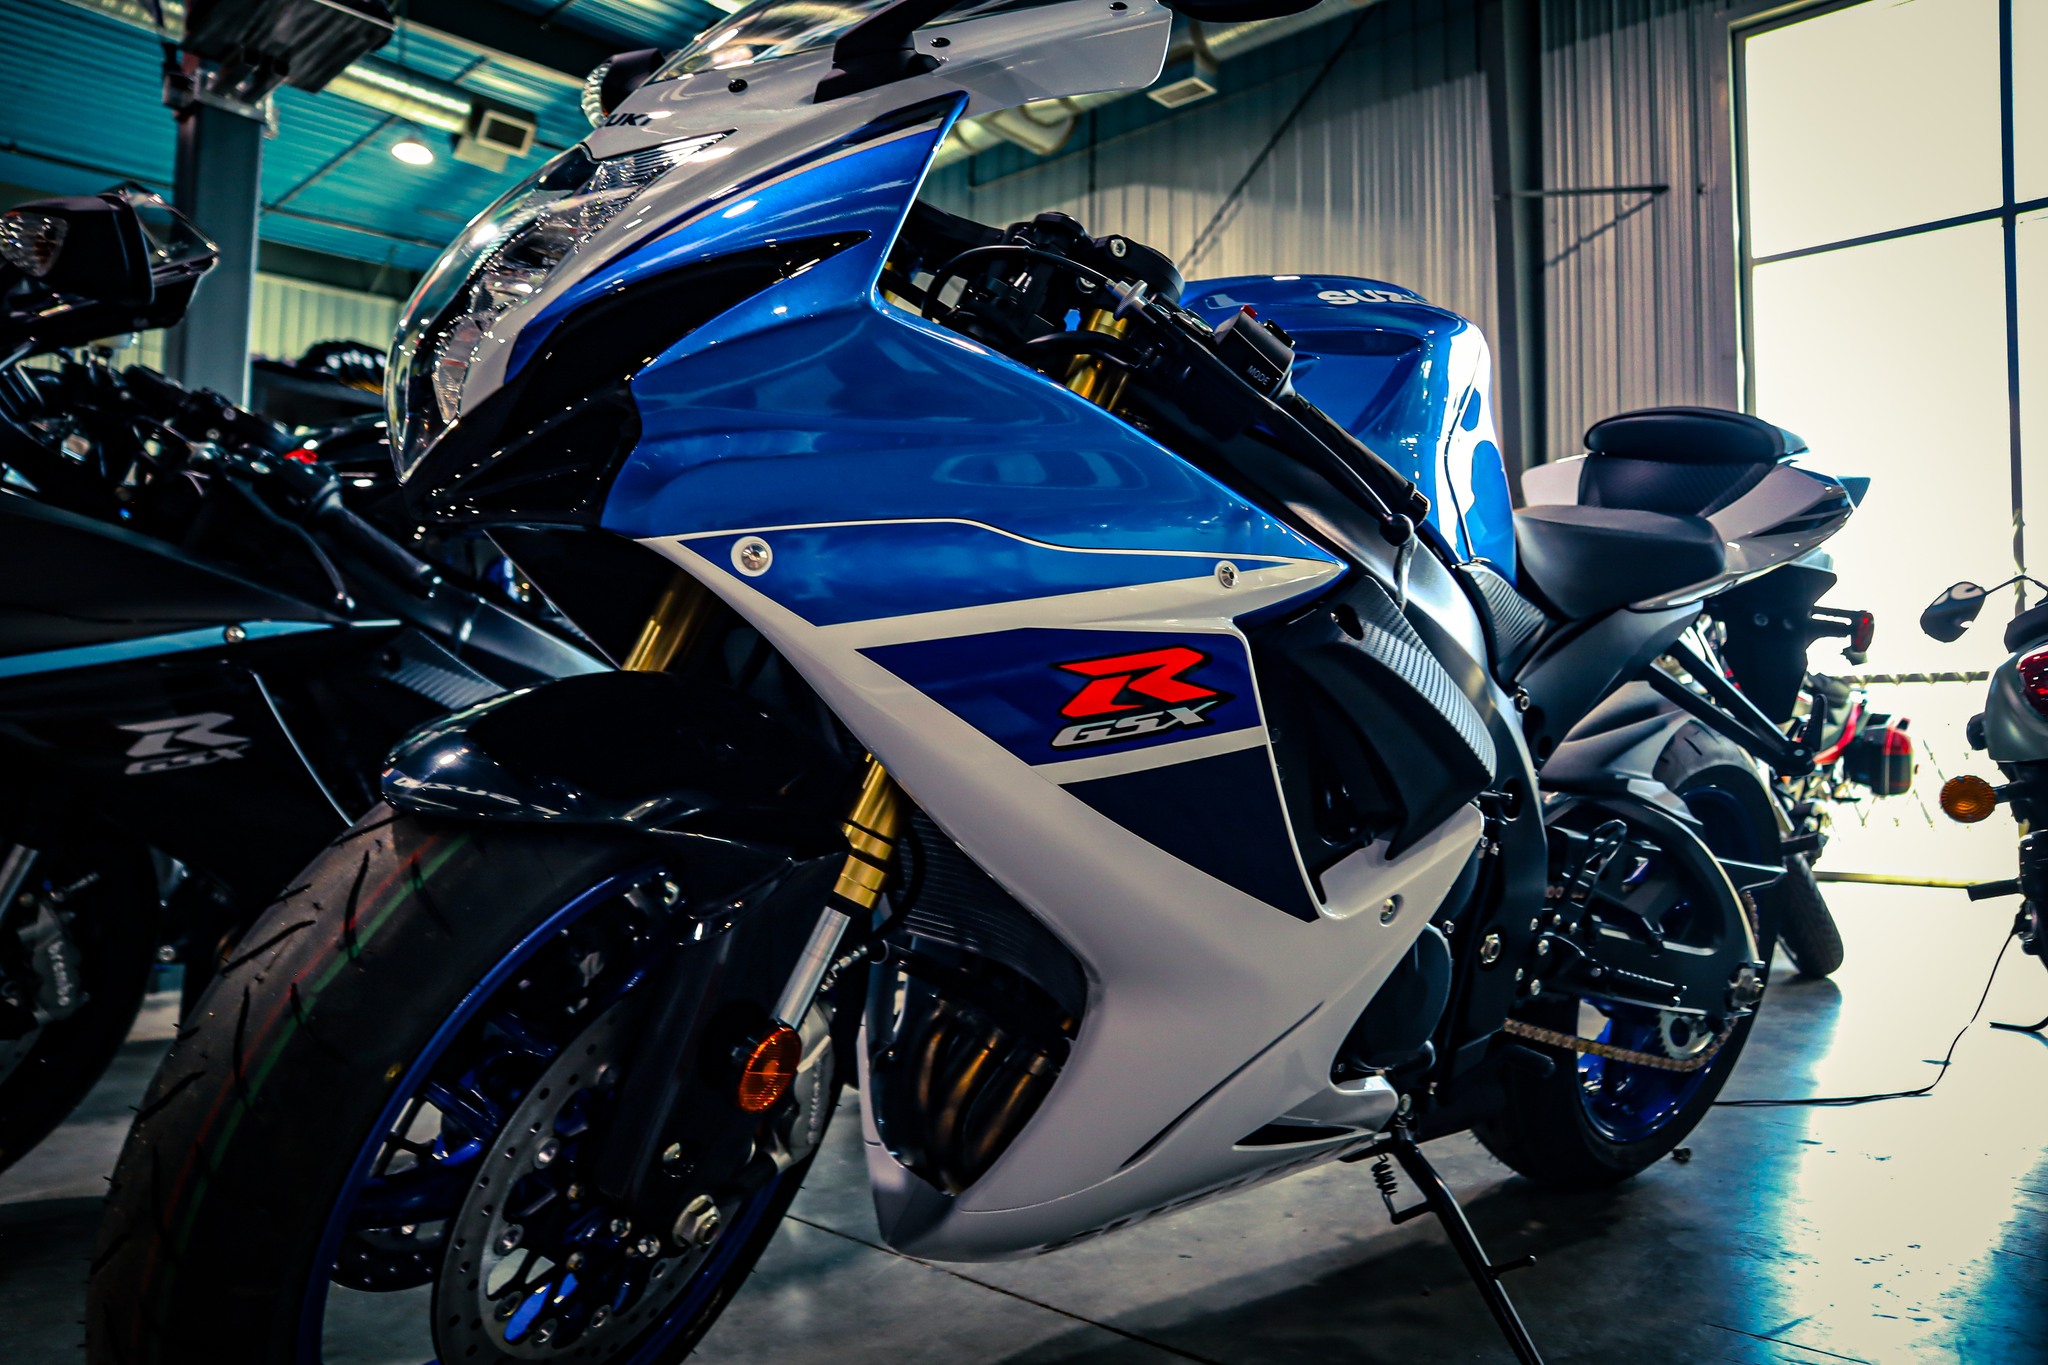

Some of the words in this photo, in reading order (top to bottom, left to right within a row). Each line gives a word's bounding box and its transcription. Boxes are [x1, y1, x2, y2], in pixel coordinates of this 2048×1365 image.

[1317, 289, 1438, 306] SUZ
[1246, 364, 1271, 386] MODE
[1058, 647, 1218, 718] R
[117, 711, 251, 758] R
[1051, 700, 1218, 747] GSX
[124, 744, 251, 775] GSX
